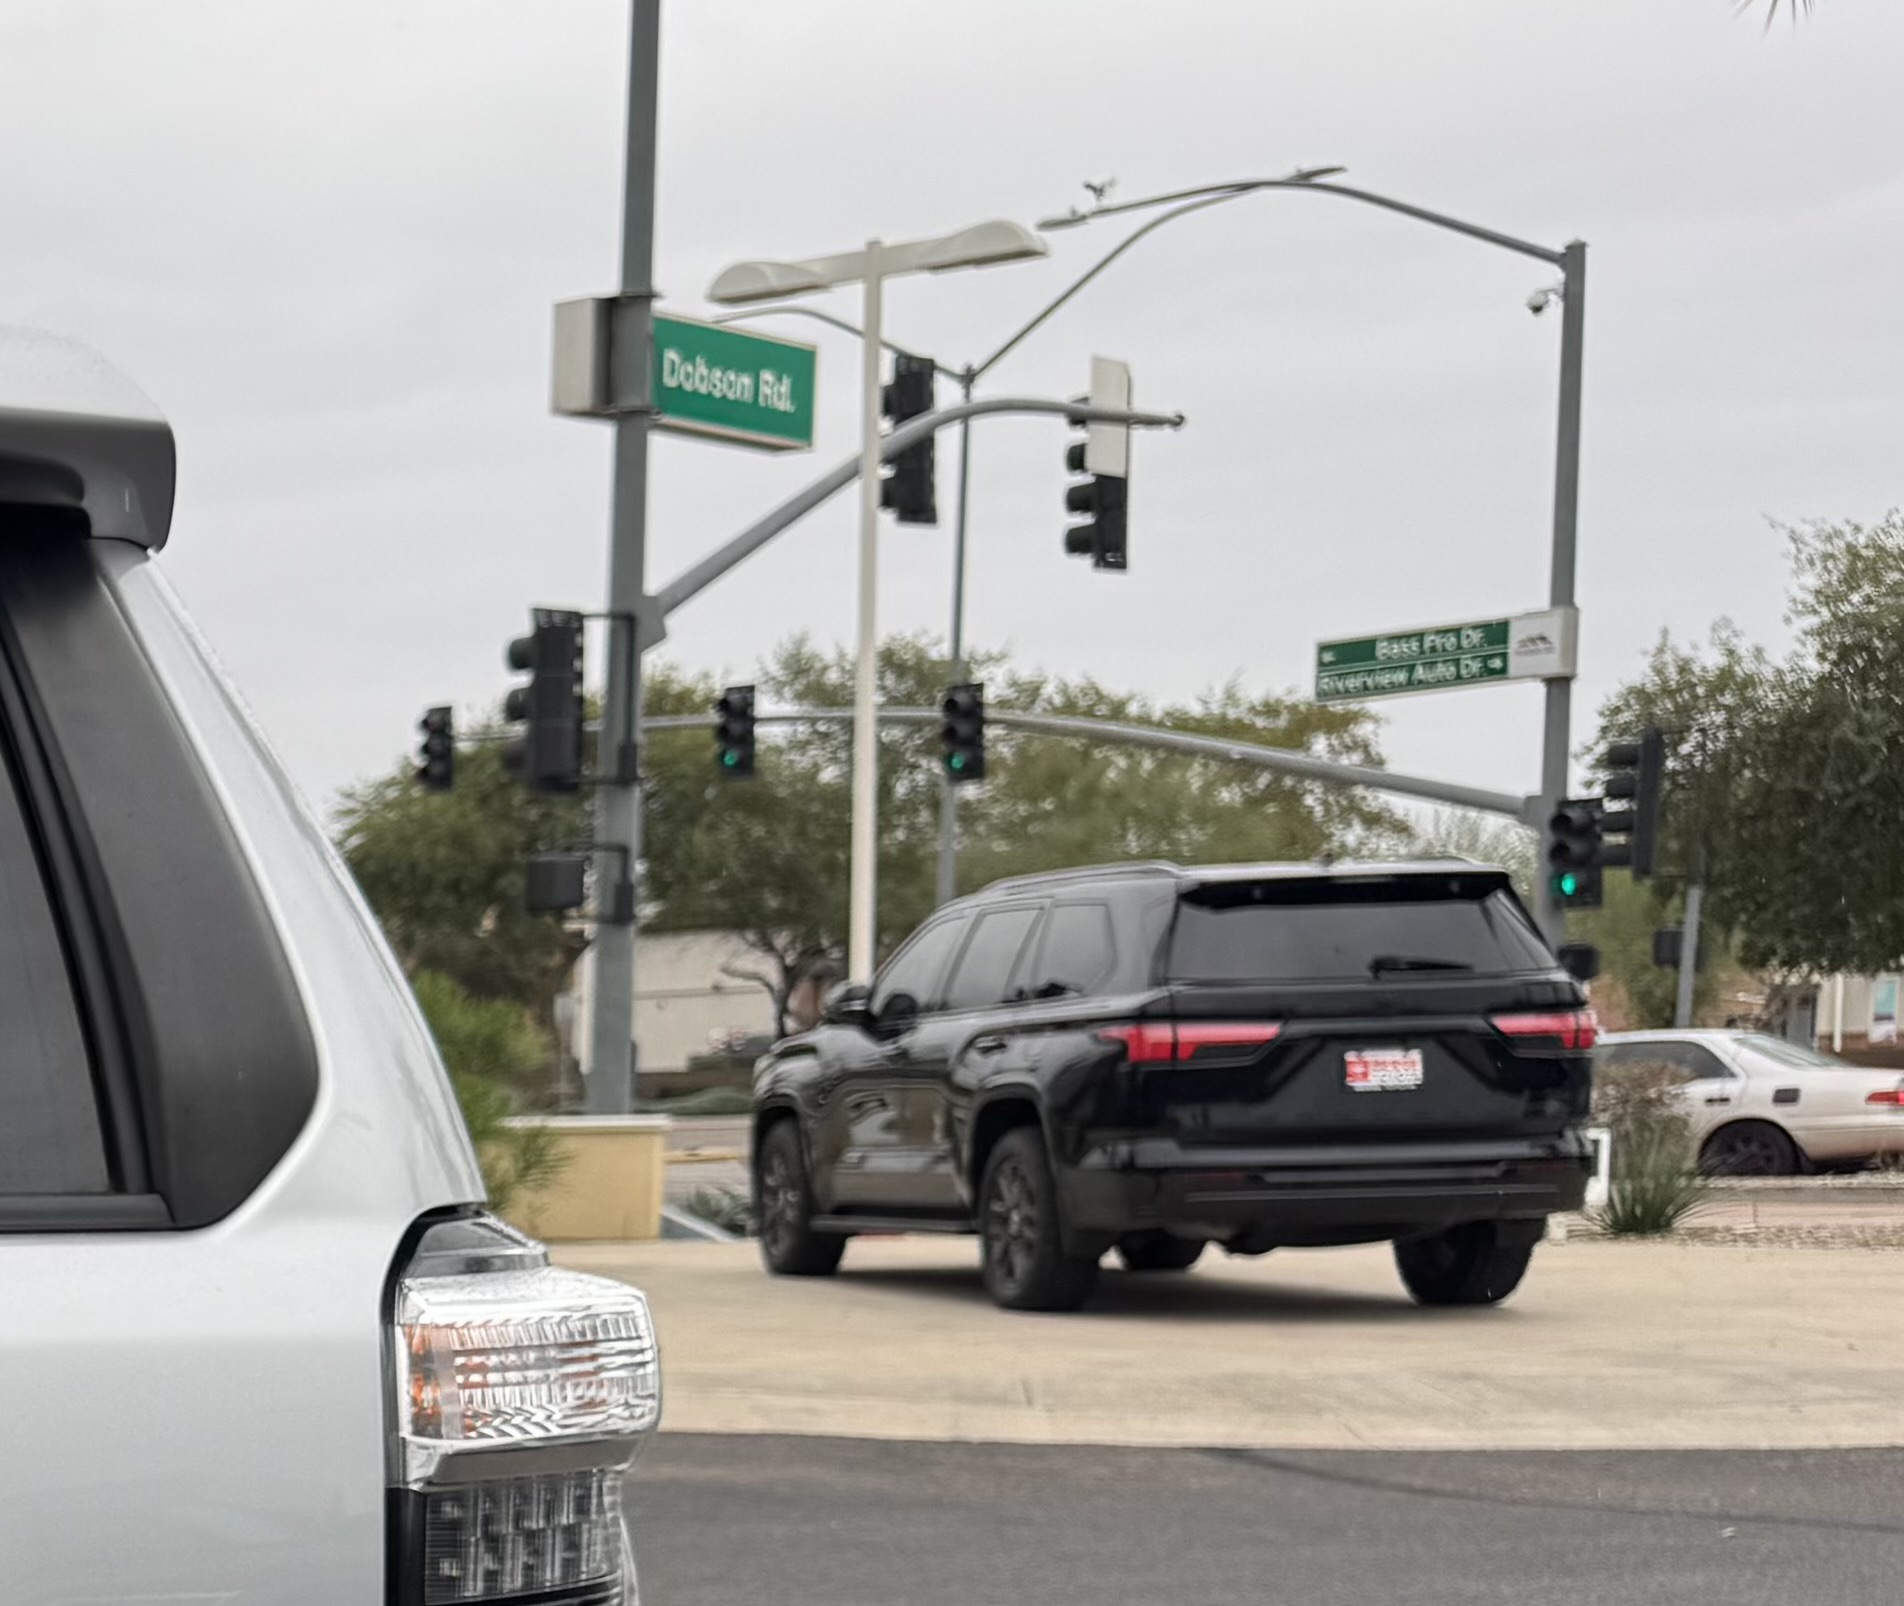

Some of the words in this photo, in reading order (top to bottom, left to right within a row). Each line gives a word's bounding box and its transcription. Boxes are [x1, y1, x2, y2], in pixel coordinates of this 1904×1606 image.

[663, 349, 754, 403] Dobson
[758, 370, 797, 413] Rd.
[1376, 637, 1420, 660] Bass
[1423, 632, 1457, 654] Pro
[1411, 661, 1457, 685] Auto
